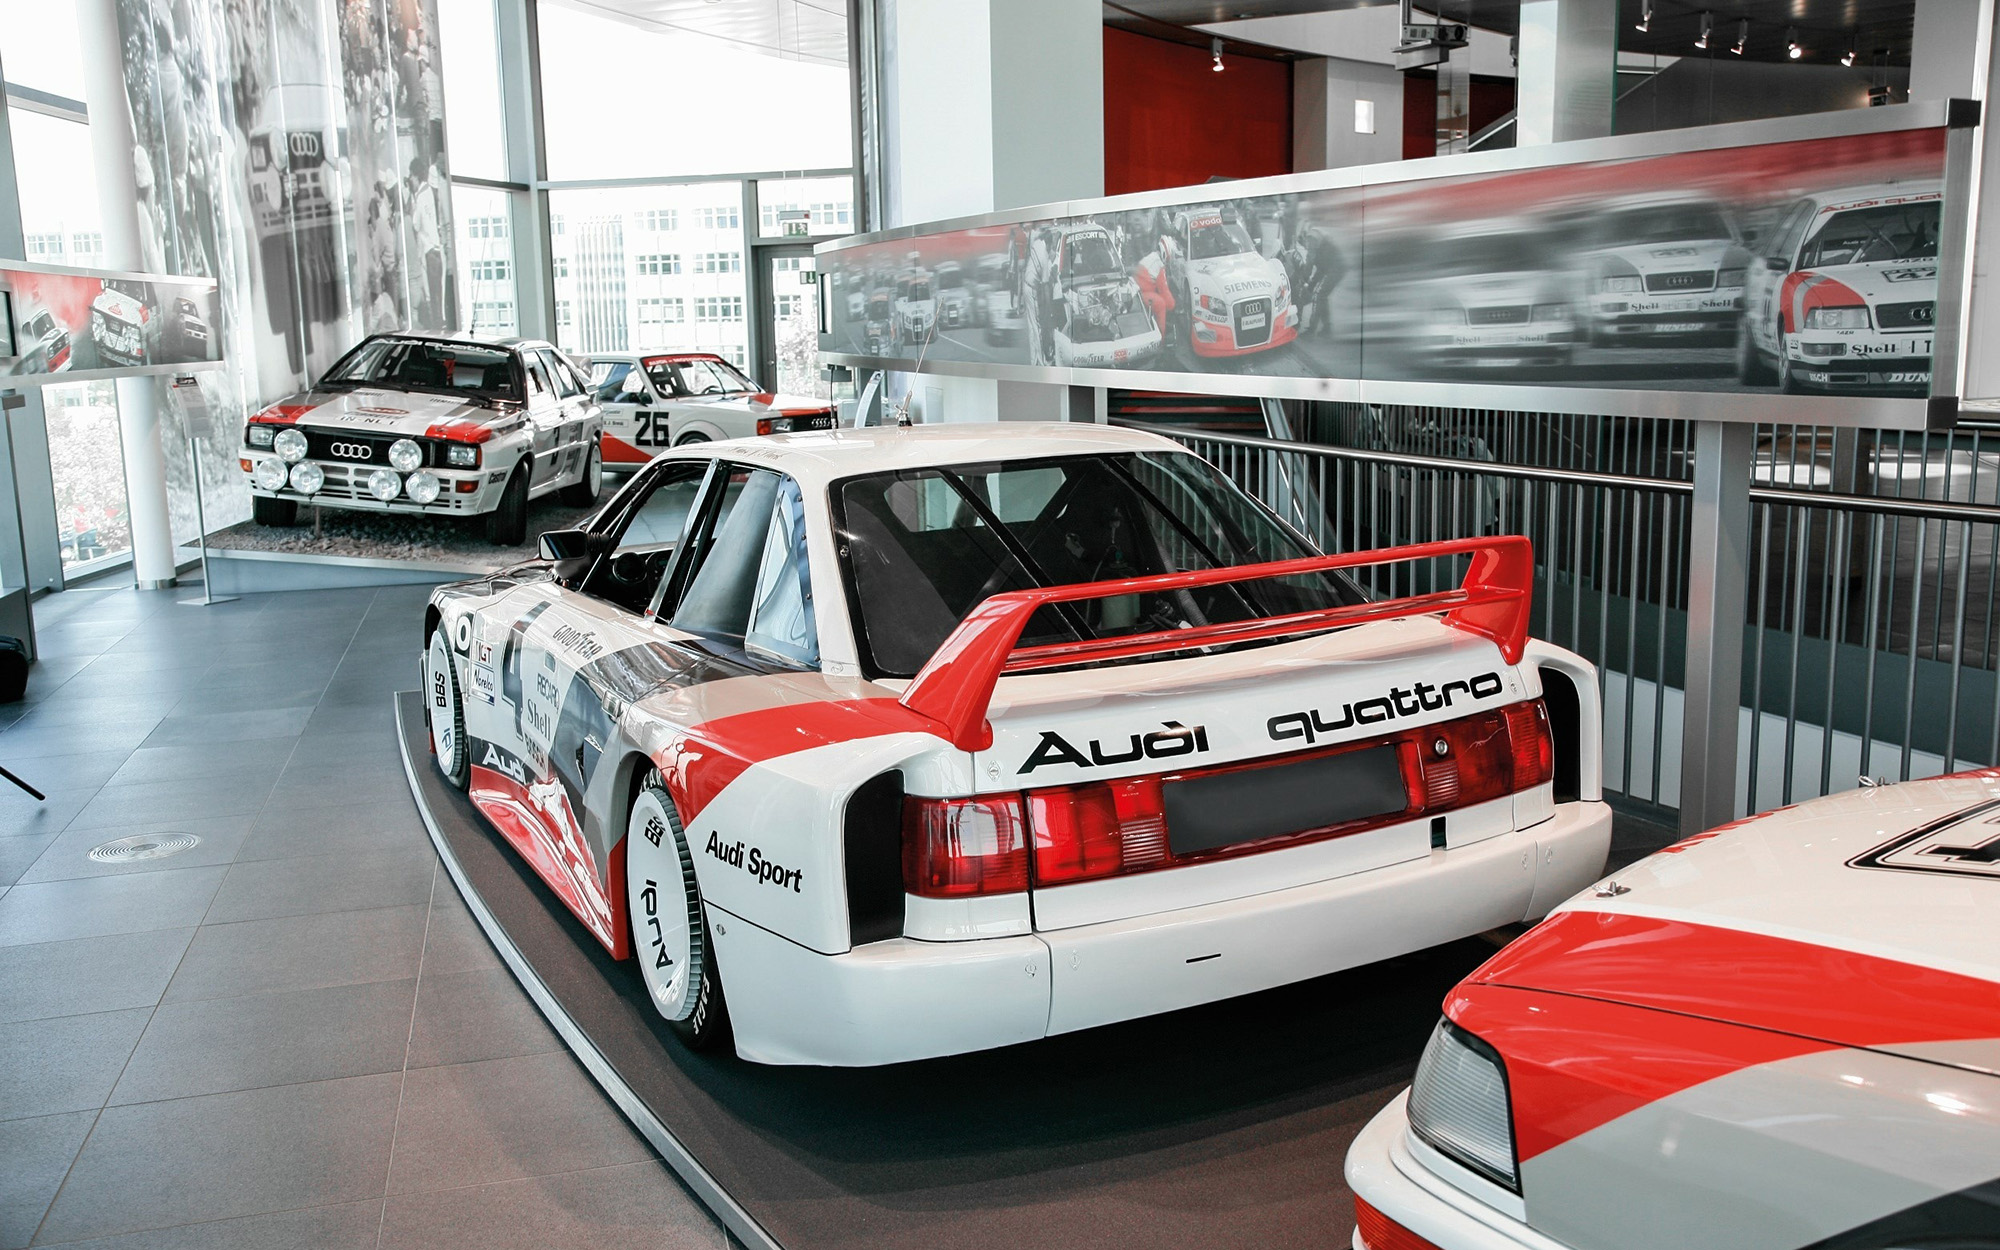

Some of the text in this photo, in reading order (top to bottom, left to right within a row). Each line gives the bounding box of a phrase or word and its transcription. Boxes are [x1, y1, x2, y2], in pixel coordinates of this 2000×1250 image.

[1224, 280, 1272, 295] SIEMENS
[1701, 298, 1732, 309] Shell
[1630, 302, 1660, 313] Shell
[1851, 343, 1896, 354] Shell
[634, 411, 670, 448] 26
[434, 670, 447, 708] BBS
[527, 698, 551, 742] Shell
[1016, 671, 1504, 775] Audi quattro
[704, 830, 804, 894] Audi Sport
